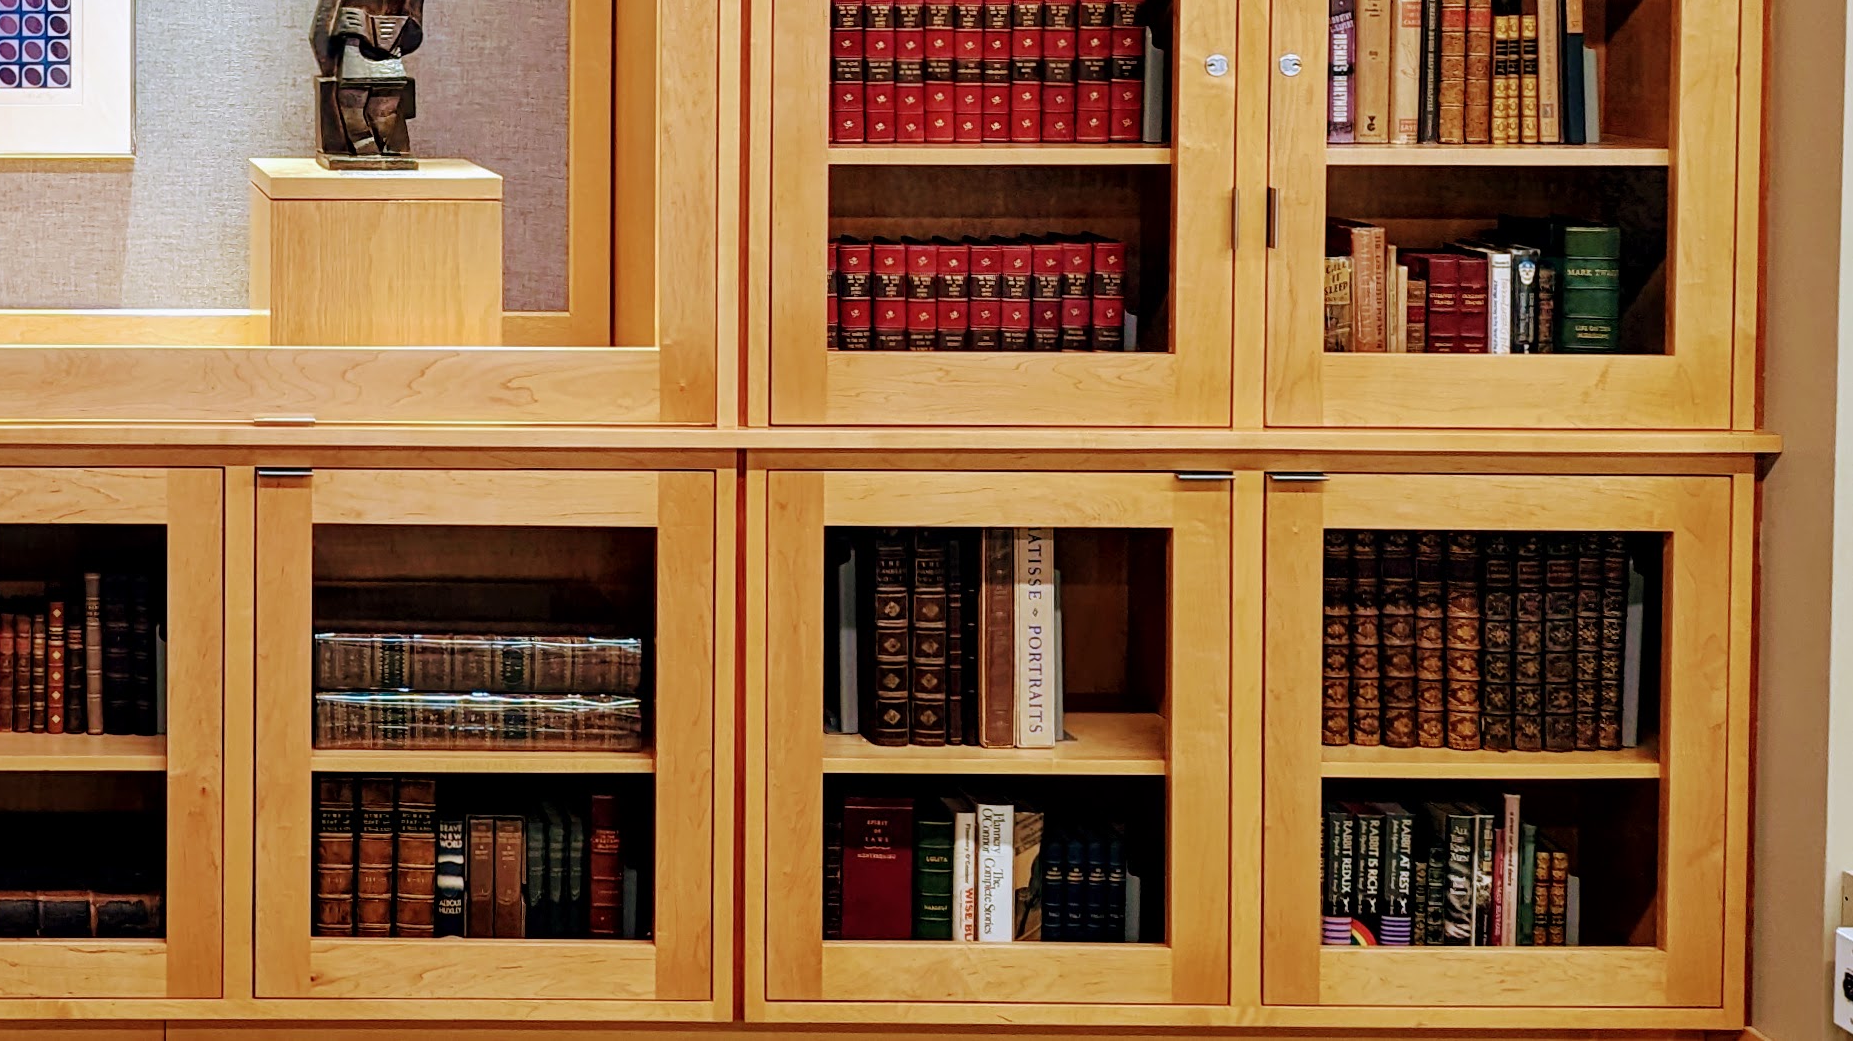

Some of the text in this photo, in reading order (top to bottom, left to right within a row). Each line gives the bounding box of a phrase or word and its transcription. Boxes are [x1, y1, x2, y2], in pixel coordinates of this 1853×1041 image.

[1332, 33, 1348, 123] BUSMAN'S HONEYMOON
[1324, 281, 1348, 295] SLEEP
[1326, 261, 1347, 273] CALL
[1332, 273, 1341, 283] IT
[1567, 269, 1593, 277] MARK
[1027, 625, 1043, 734] PORTRAITS
[439, 823, 463, 832] BRAVE
[439, 839, 463, 849] WORLD
[982, 807, 994, 854] O'Connor
[992, 812, 1006, 854] Flannery
[925, 855, 949, 863] LOLITA
[1341, 819, 1353, 894] RABBIT REDUX
[1366, 819, 1381, 895] RABBIT IS RICH
[1398, 819, 1413, 896] RABBIT AT REST
[982, 857, 996, 935] Complete Stories
[992, 868, 1004, 889] The
[964, 887, 974, 941] WISE BL
